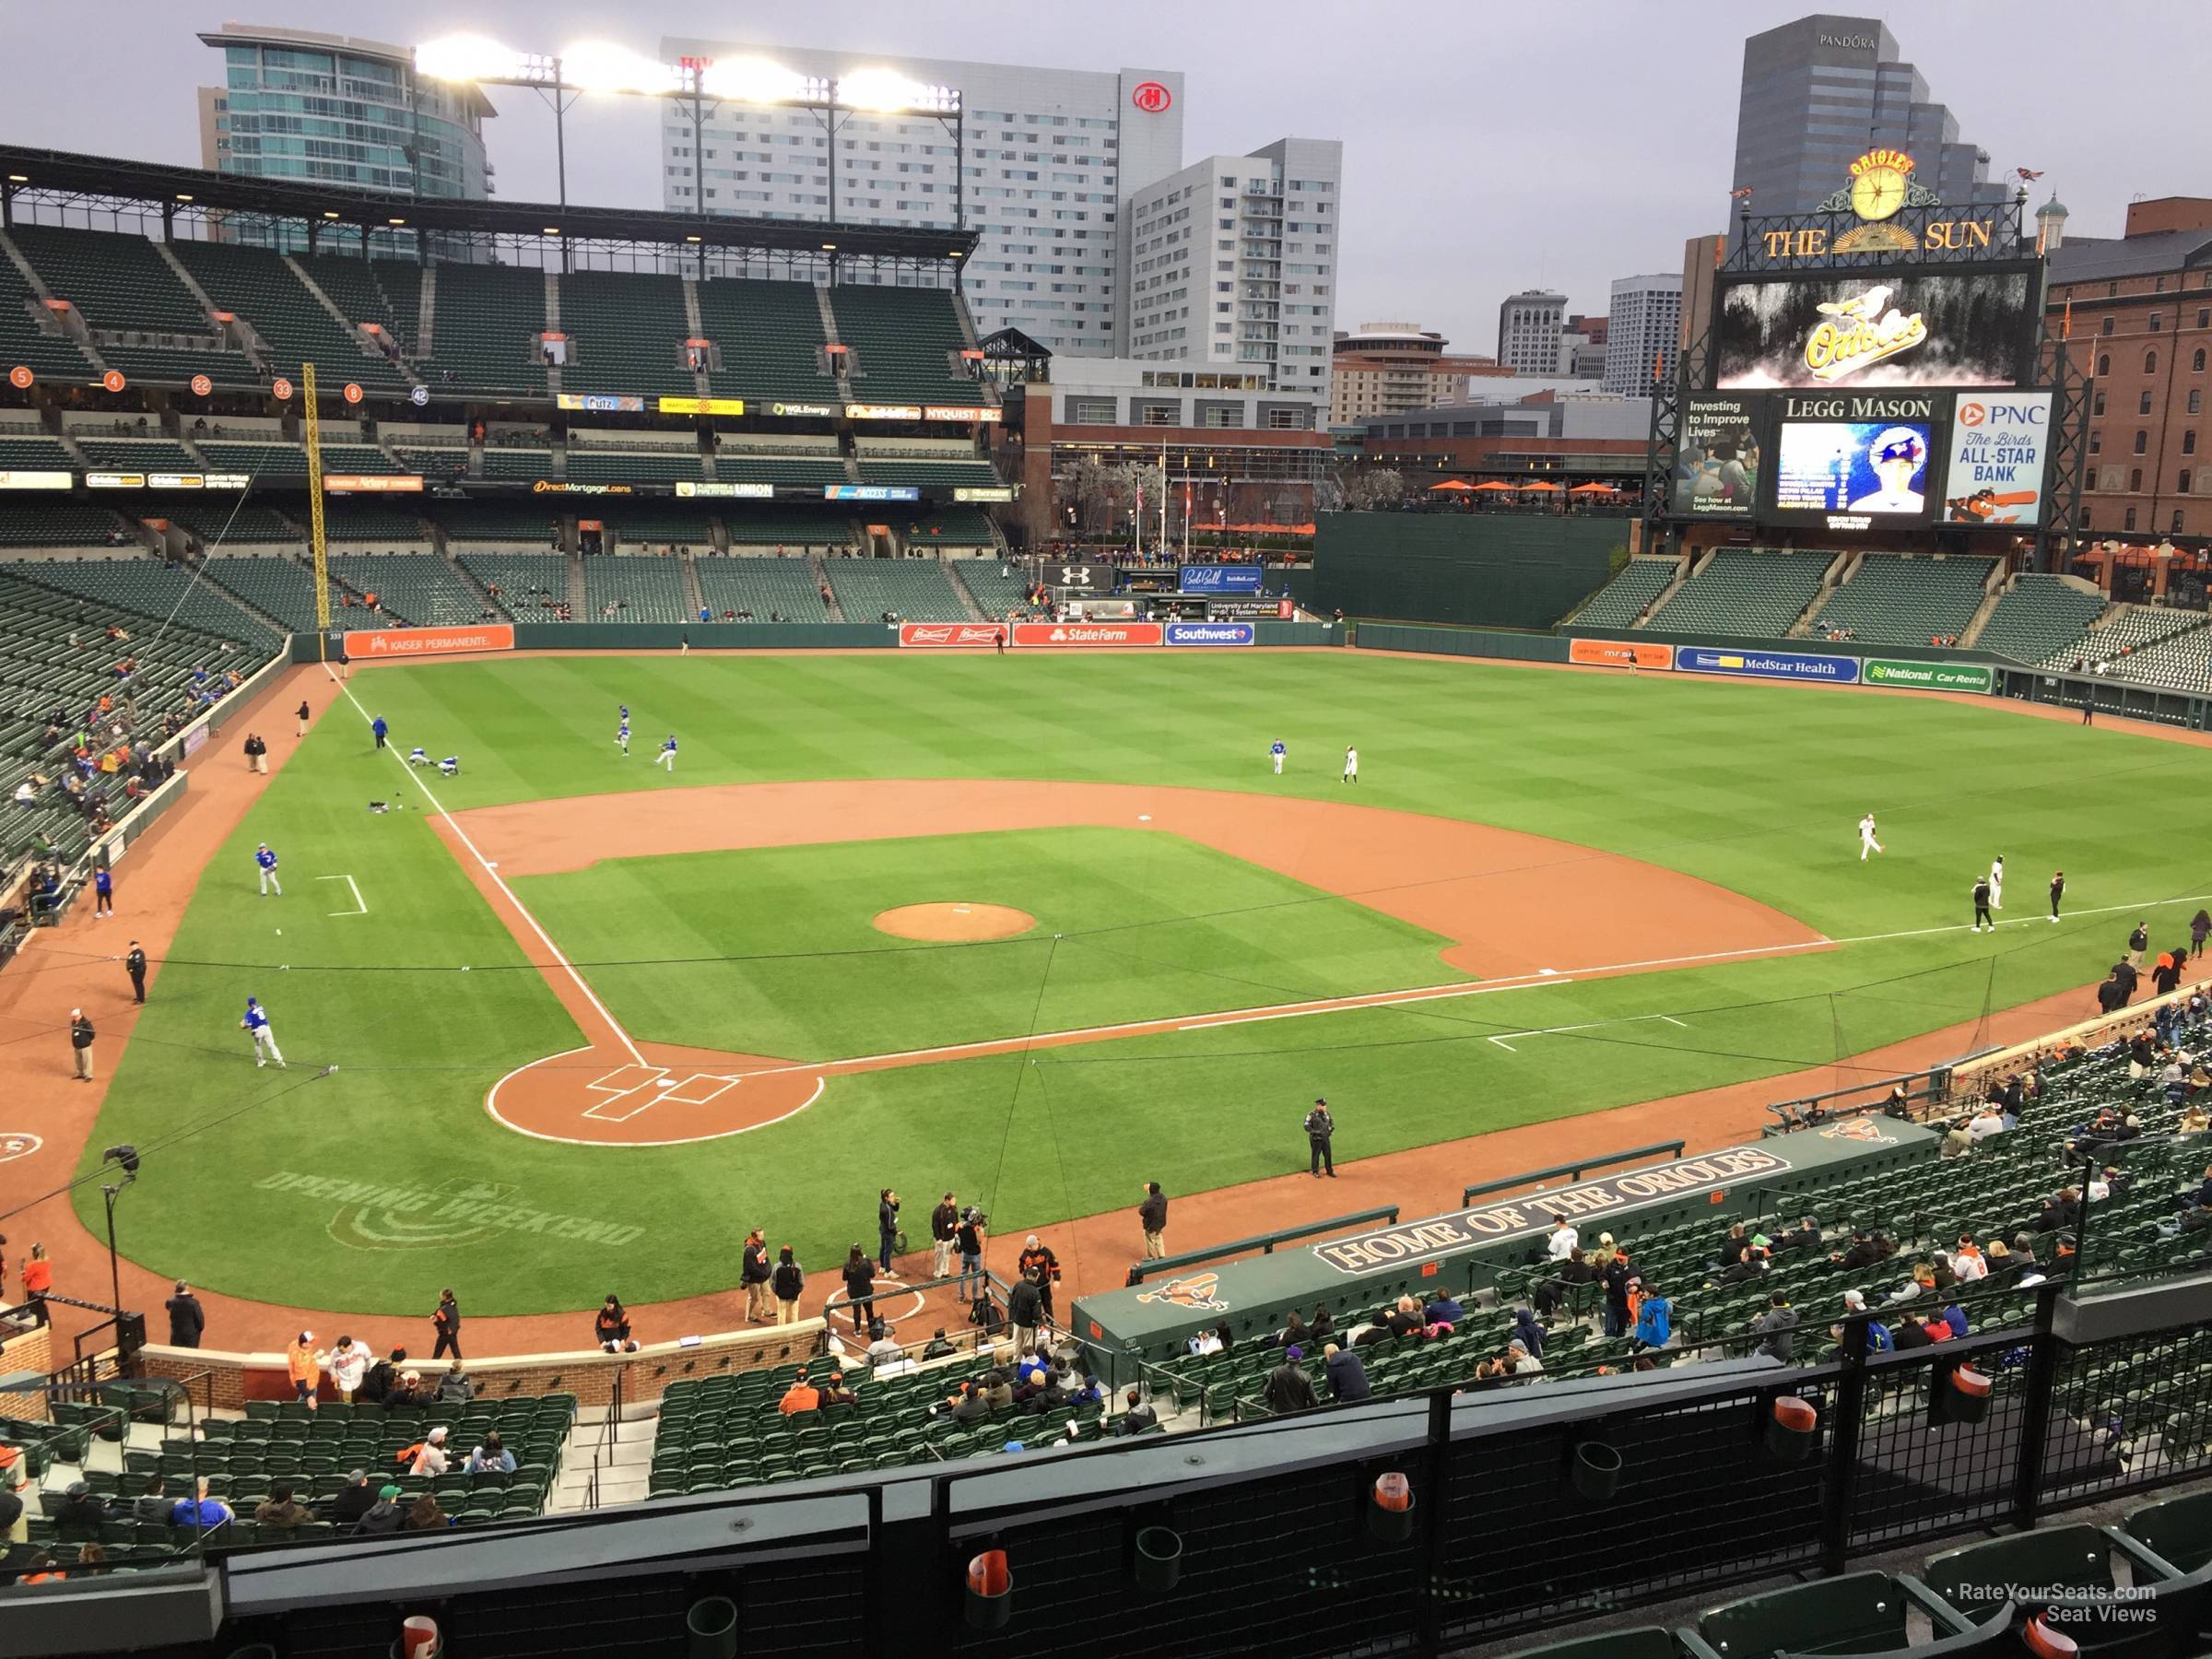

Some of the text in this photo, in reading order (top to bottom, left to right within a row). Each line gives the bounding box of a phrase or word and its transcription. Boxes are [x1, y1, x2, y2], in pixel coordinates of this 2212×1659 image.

[1850, 150, 1915, 175] ORIOLES
[1764, 220, 1993, 257] THE SUN
[1806, 311, 1927, 376] Orioles
[194, 380, 208, 391] 22
[276, 384, 289, 394] 33
[414, 391, 426, 402] 42
[1689, 400, 1741, 413] Investing
[1786, 397, 1933, 418] LEGG MASON
[1688, 414, 1749, 426] to Improve
[1990, 406, 2046, 424] PNC
[1966, 431, 2033, 445] The Birds
[1959, 447, 2036, 464] ALL-STAR
[1974, 465, 2017, 482] BANK
[735, 484, 773, 495] UNION
[1693, 503, 1748, 512] LeggMason.com
[1174, 628, 1237, 641] Southwest
[391, 636, 488, 651] KAISER PERMANENTE
[1746, 659, 1836, 675] MedStar Health
[1886, 667, 1986, 686] National Car Rental
[253, 1171, 646, 1246] OPENING WEEKEND
[1324, 1150, 1777, 1268] HOME OF THE ORIOLES
